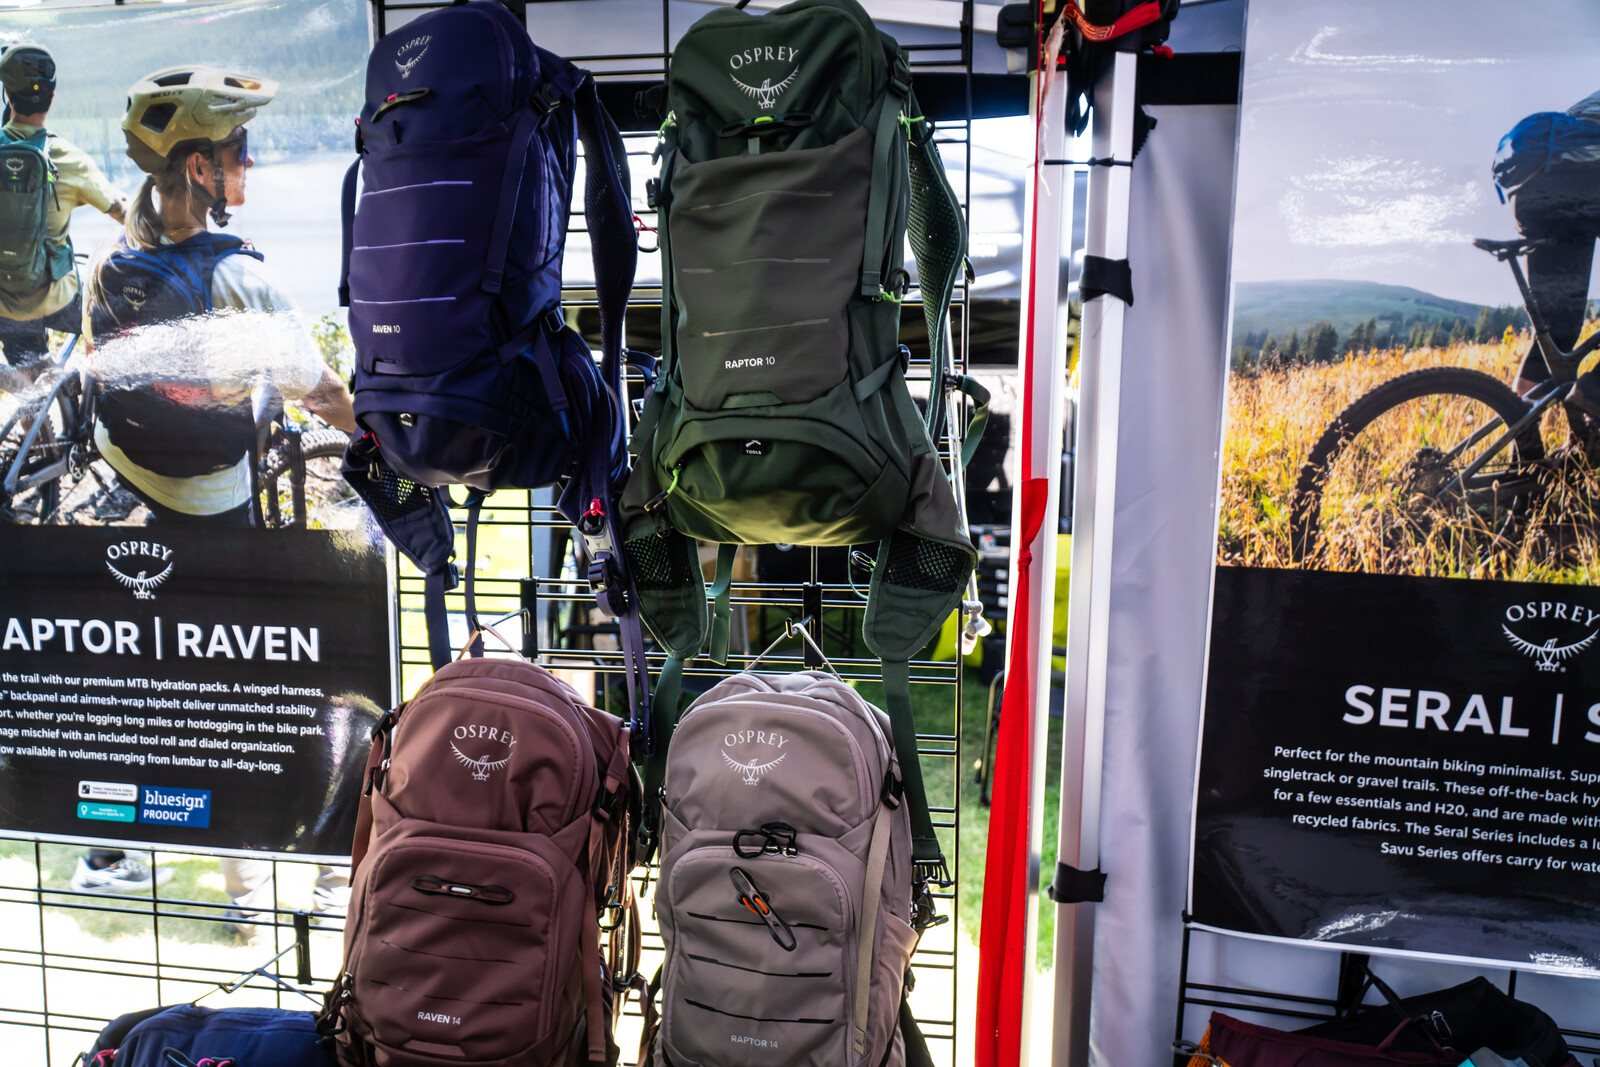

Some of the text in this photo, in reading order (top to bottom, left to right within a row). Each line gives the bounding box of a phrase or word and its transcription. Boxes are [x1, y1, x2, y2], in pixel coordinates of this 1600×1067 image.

[397, 35, 432, 56] OSPREY
[730, 46, 799, 69] OSPREY
[150, 90, 184, 99] SCOTT
[123, 286, 146, 298] OSPREY
[372, 324, 400, 333] RAVEN 10
[725, 356, 775, 369] RAPTOR 10
[107, 541, 173, 561] OSPREY
[1506, 601, 1600, 627] OSPREY
[2, 617, 141, 655] APTOR
[177, 622, 320, 662] RAVEN
[2, 672, 324, 697] the trail with our premium MTB hydration packs. A winged harness,
[10, 691, 58, 703] backpanel
[60, 692, 78, 703] and
[80, 694, 144, 708] airmesh-wrap
[147, 697, 180, 709] hipbelt
[183, 699, 215, 711] deliver
[218, 702, 273, 713] unmatched
[276, 705, 316, 718] stability
[1342, 684, 1530, 737] SERAL
[16, 709, 53, 720] whether
[56, 711, 85, 723] you're
[87, 712, 121, 726] logging
[124, 714, 145, 728] long
[147, 716, 172, 727] miles
[174, 719, 185, 727] or
[187, 718, 243, 733] hotdogging
[246, 721, 255, 732] in
[258, 722, 274, 733] the
[277, 723, 297, 734] bike
[300, 725, 325, 736] park.
[21, 727, 60, 739] mischief
[62, 730, 81, 741] with
[84, 733, 96, 741] an
[98, 732, 137, 744] included
[139, 734, 158, 745] tool
[160, 736, 176, 746] roll
[178, 737, 197, 748] and
[199, 738, 229, 750] dialed
[231, 740, 295, 753] organization.
[454, 724, 517, 748] OSPREY
[724, 730, 789, 748] OSPREY
[0, 745, 283, 774] ow available in volumes ranging from lumbar to all-day-long.
[1274, 746, 1322, 760] Perfect
[1325, 749, 1345, 762] for
[1348, 752, 1371, 764] the
[1374, 755, 1439, 769] mountain
[1443, 759, 1485, 776] biking
[1489, 764, 1565, 780] minimalist.
[1263, 767, 1336, 783] singletrack
[1339, 775, 1353, 784] or
[1357, 777, 1398, 788] gravel
[1402, 778, 1439, 792] trails.
[1444, 781, 1485, 795] These
[1489, 785, 1579, 804] off-the-back
[143, 809, 190, 822] PRODUCT
[1273, 788, 1293, 801] for
[1296, 793, 1304, 802] a
[1308, 791, 1332, 804] few
[1335, 797, 1402, 810] essentials
[1405, 801, 1431, 813] and
[1472, 807, 1499, 819] and
[1502, 810, 1525, 821] are
[1529, 813, 1568, 825] made
[1572, 815, 1600, 828] with
[1292, 813, 1348, 828] recycled
[1352, 816, 1400, 832] fabrics.
[1404, 822, 1430, 835] The
[1434, 824, 1468, 838] Seral
[1472, 828, 1514, 843] Series
[1517, 831, 1576, 848] includes
[1579, 839, 1588, 849] a
[1380, 842, 1413, 856] Savu
[1417, 845, 1458, 860] Series
[1462, 849, 1502, 864] offers
[1506, 855, 1543, 870] carry
[1546, 856, 1567, 869] for
[417, 1011, 461, 1025] RAVEN 14
[731, 1034, 778, 1048] RAPTOR 14
